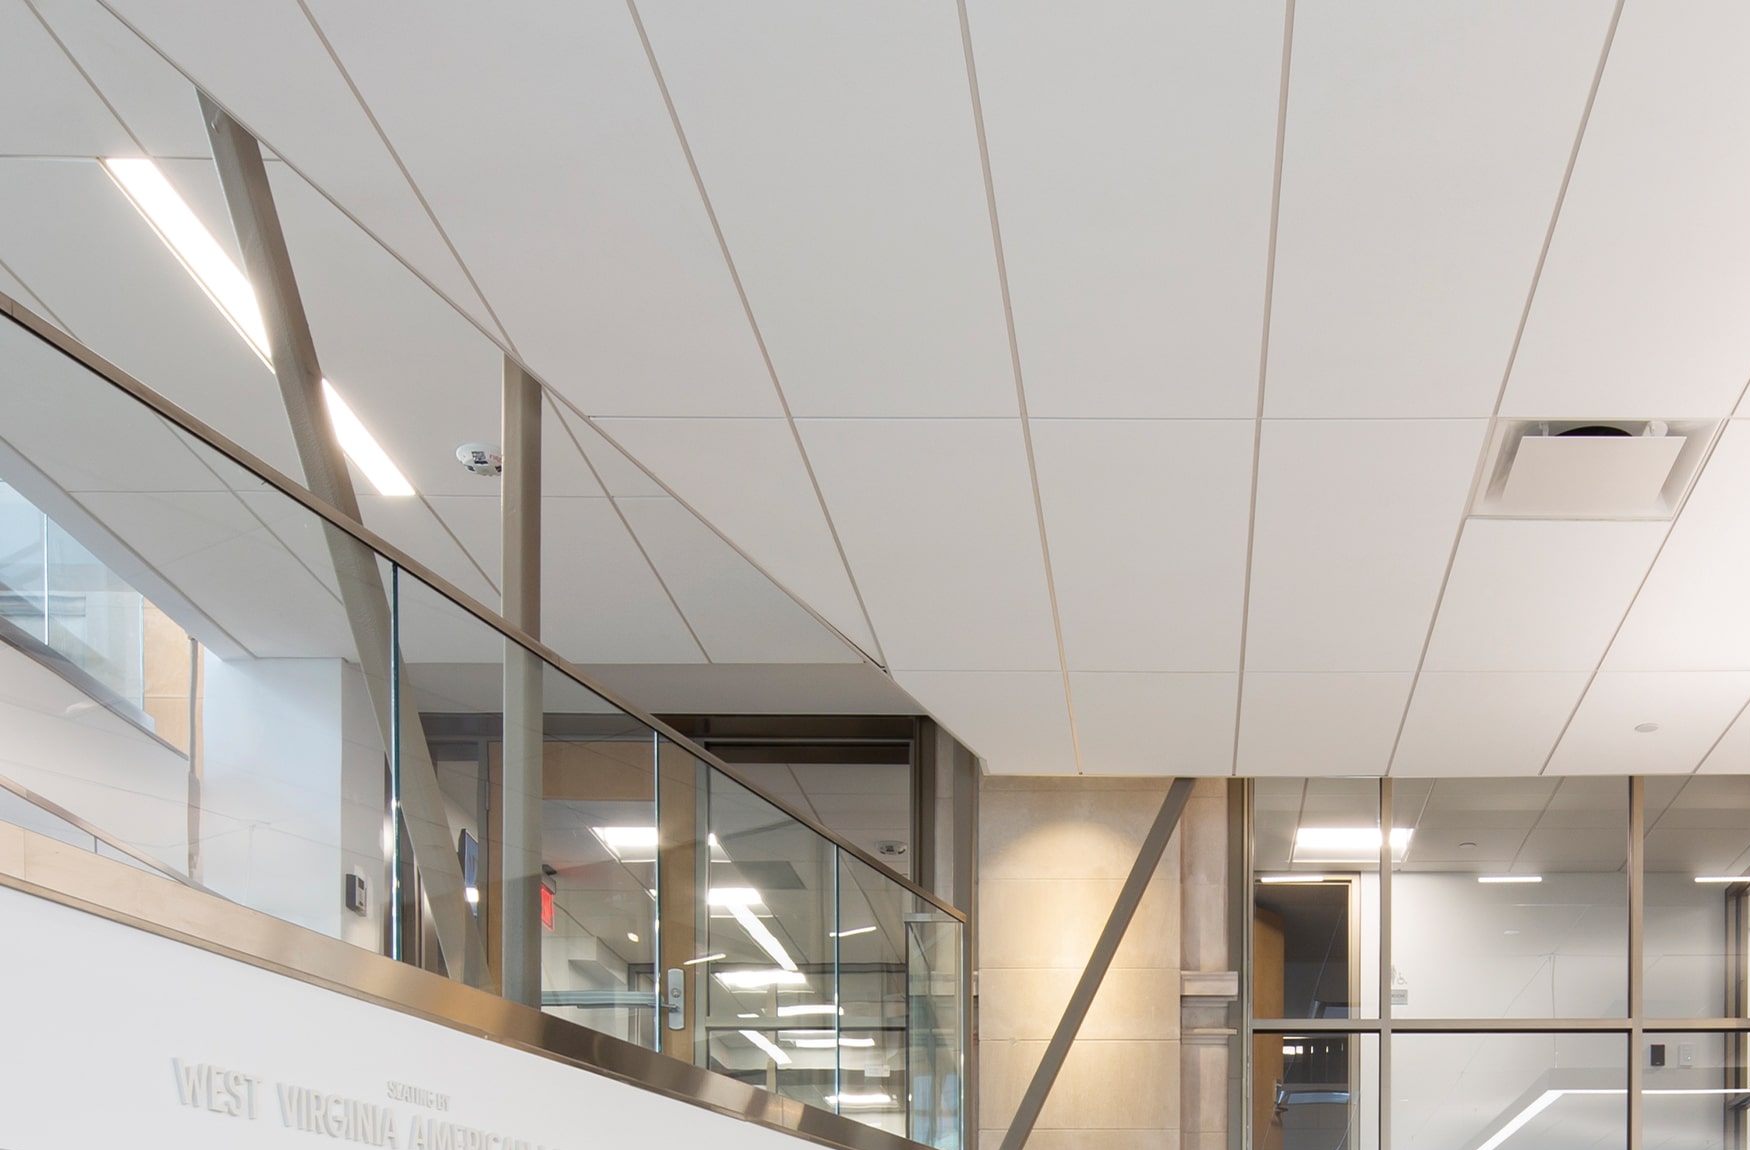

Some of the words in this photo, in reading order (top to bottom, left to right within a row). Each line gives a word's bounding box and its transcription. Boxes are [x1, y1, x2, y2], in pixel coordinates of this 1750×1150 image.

[170, 1056, 264, 1121] WEST
[275, 1082, 401, 1150] VIRGINIA
[387, 1080, 433, 1109] SEATING
[435, 1092, 451, 1112] BY
